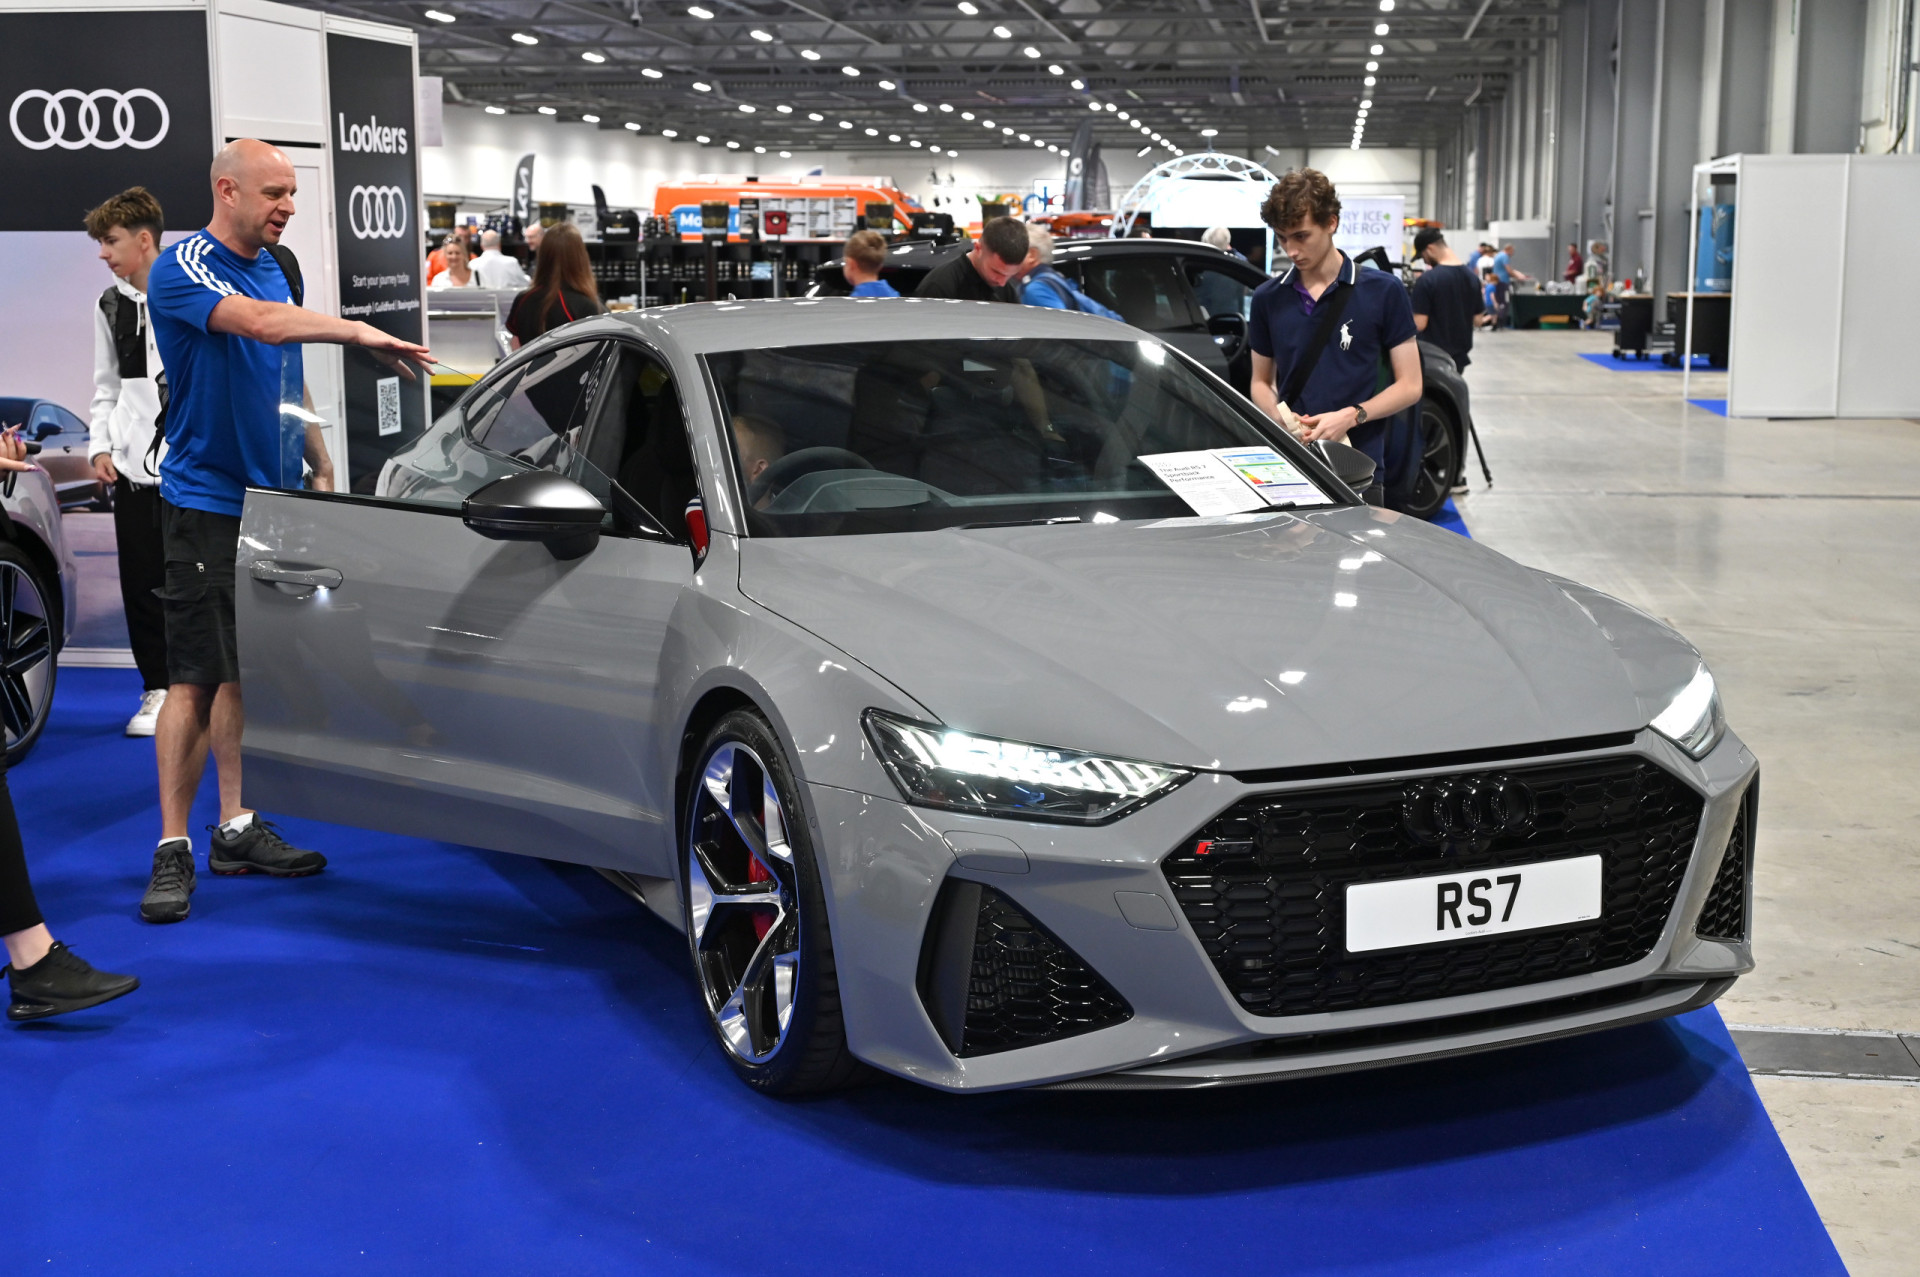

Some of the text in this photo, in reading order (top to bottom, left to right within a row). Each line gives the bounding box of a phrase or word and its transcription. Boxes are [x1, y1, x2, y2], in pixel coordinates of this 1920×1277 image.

[339, 112, 408, 155] Lookers
[1363, 210, 1383, 221] ICE
[1341, 222, 1391, 235] NERGY
[352, 272, 410, 289] Start your journey today
[1437, 873, 1522, 931] RS7
